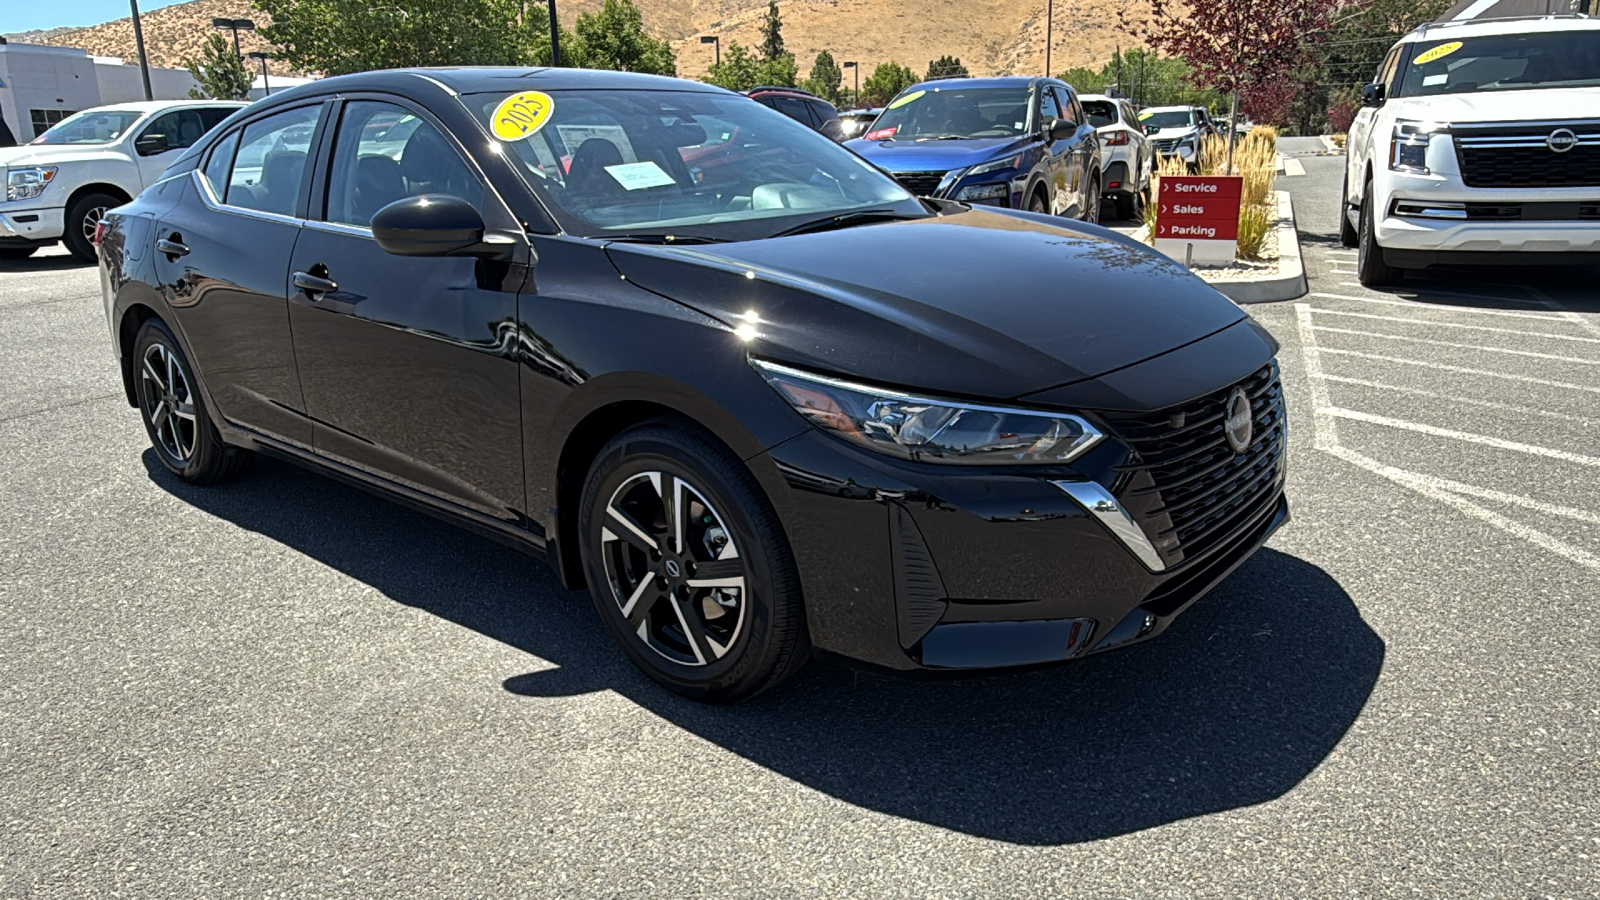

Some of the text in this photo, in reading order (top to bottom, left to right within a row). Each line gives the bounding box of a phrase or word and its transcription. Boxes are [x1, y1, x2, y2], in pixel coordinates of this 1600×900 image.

[1424, 44, 1452, 61] 2025
[501, 96, 543, 132] 2025
[1174, 183, 1218, 193] Service
[1172, 204, 1204, 214] Sales
[1170, 225, 1216, 237] Parking
